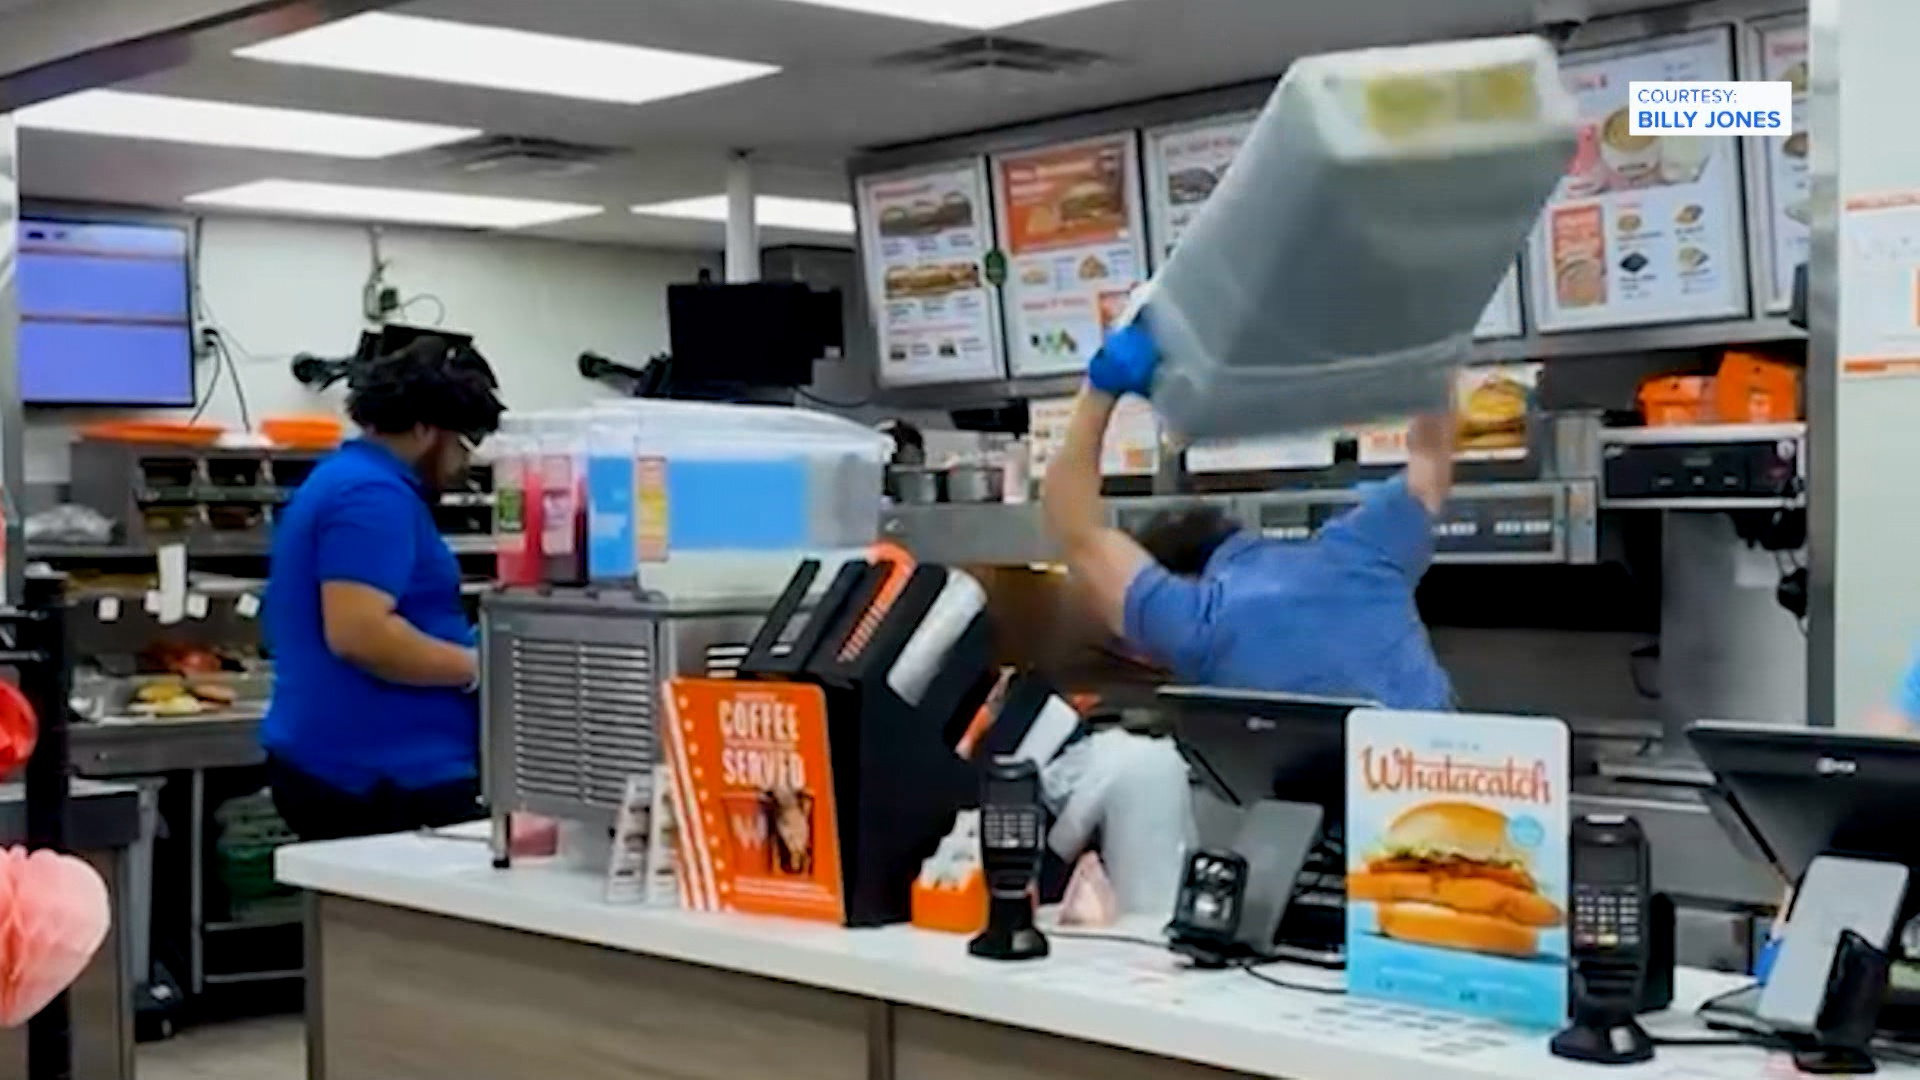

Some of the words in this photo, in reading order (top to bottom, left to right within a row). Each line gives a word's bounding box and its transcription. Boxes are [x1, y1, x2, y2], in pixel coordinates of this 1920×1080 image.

[718, 699, 799, 740] COFFEE
[721, 749, 806, 787] SERVED
[1361, 745, 1552, 804] Whatacatch
